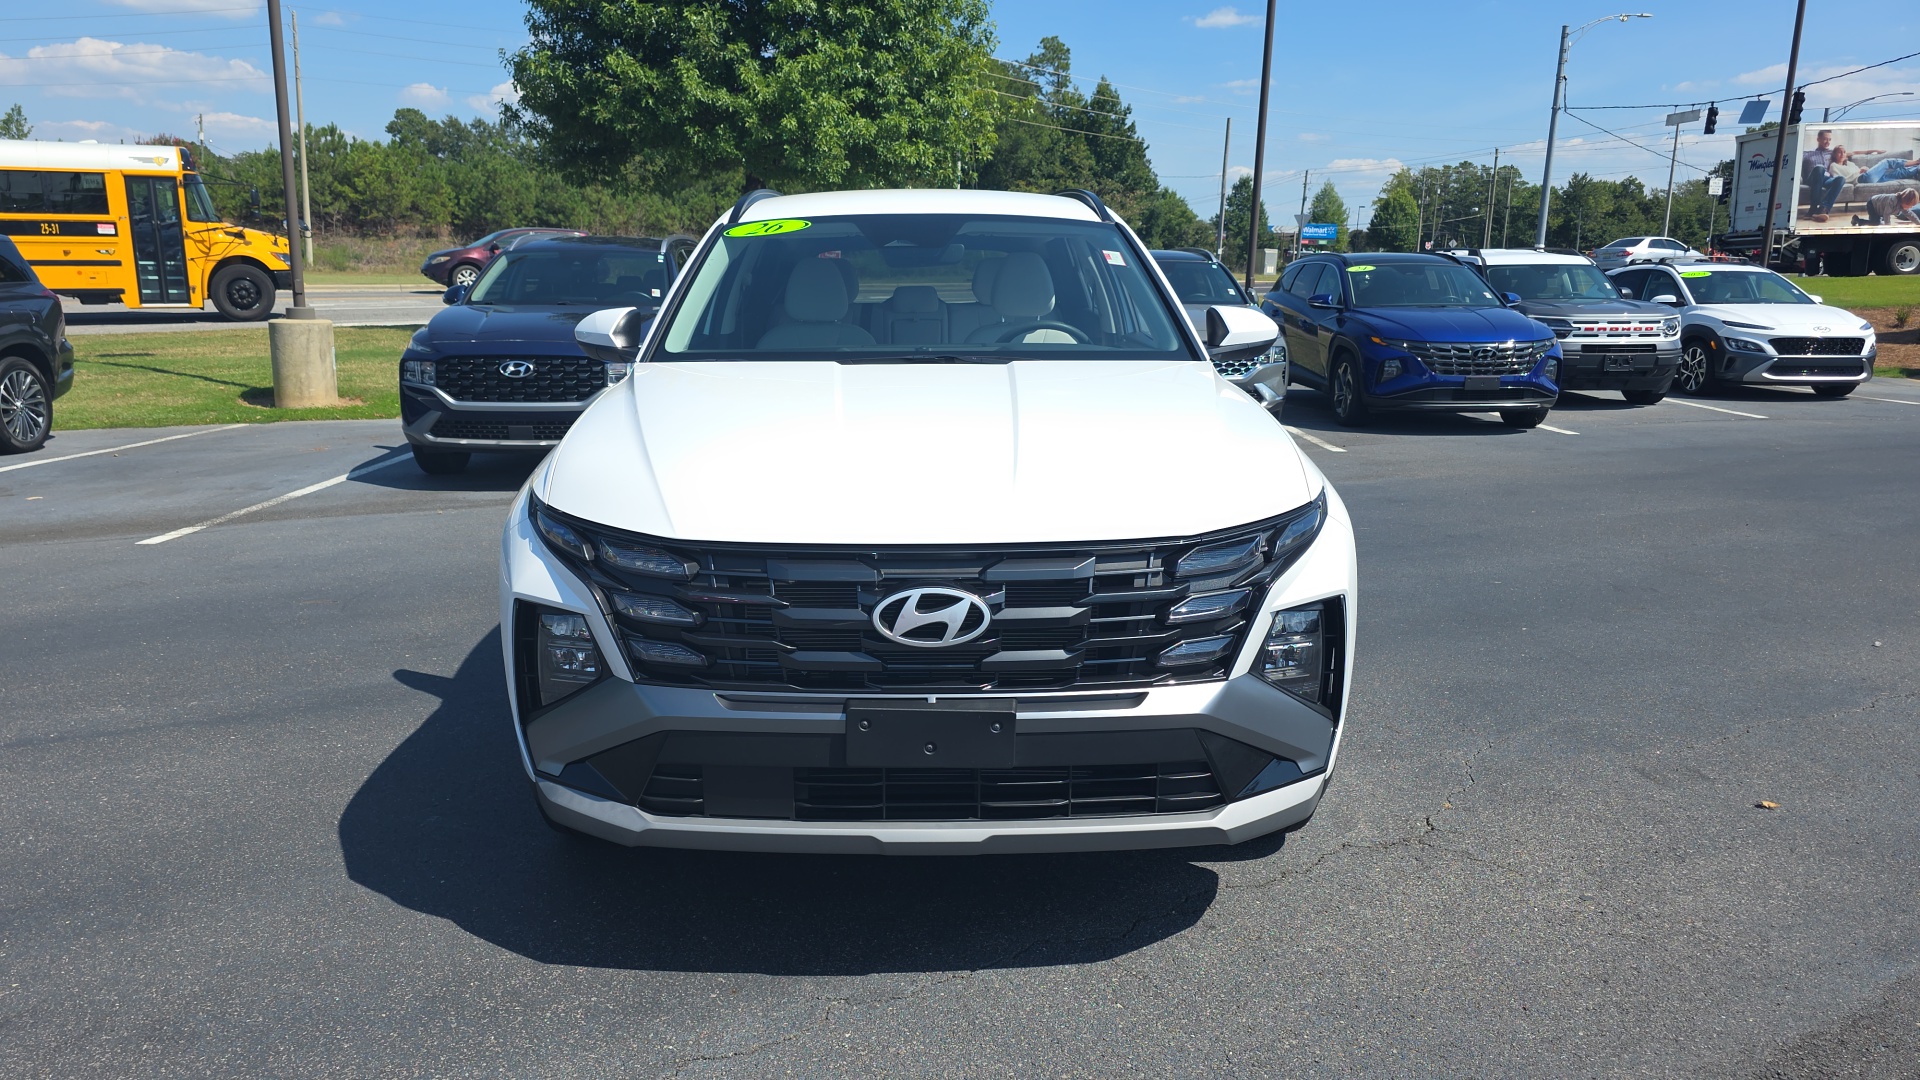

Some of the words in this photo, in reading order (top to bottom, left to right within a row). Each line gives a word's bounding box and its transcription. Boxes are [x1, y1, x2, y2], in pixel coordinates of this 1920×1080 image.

[41, 223, 60, 235] 25-31
[743, 222, 784, 235] 26
[1303, 226, 1327, 234] Walmart
